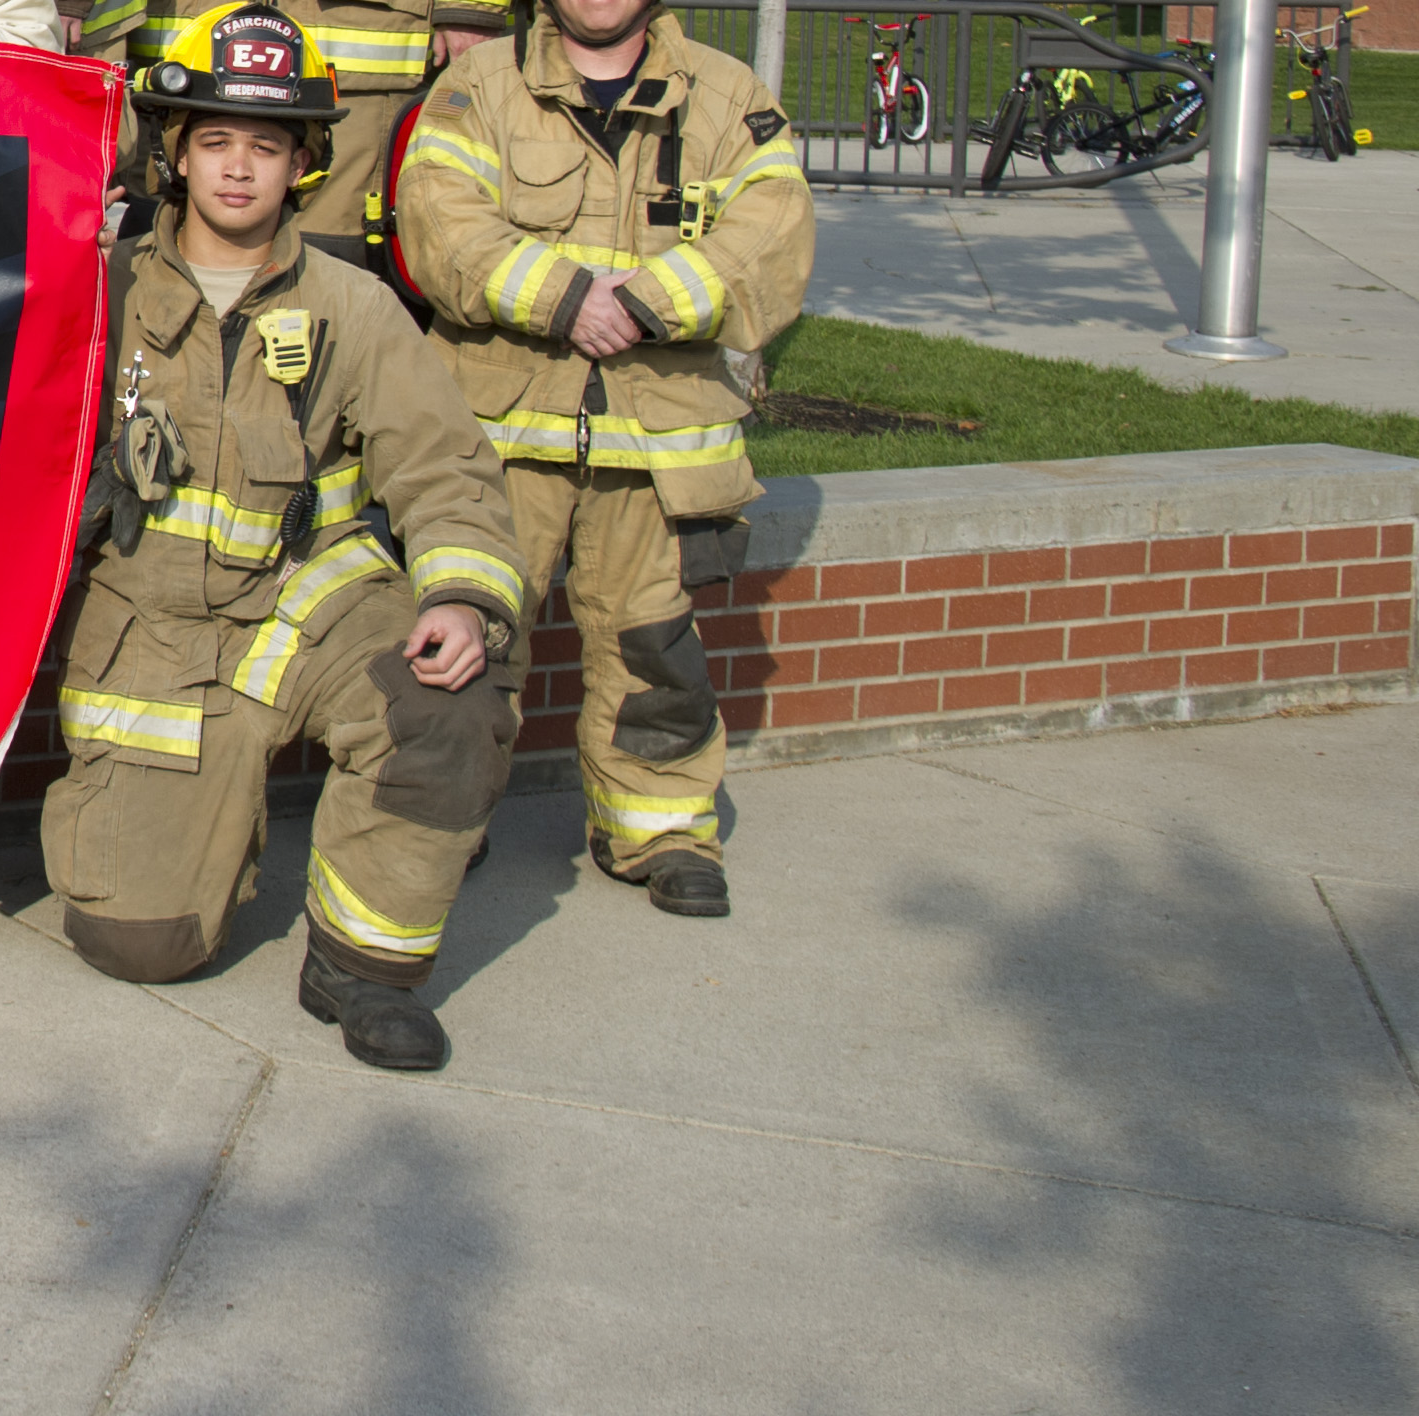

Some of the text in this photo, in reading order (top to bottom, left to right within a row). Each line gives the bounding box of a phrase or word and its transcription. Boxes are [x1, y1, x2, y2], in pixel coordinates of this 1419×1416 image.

[223, 18, 292, 36] FAIRCHILD
[233, 44, 284, 71] E-7
[225, 84, 287, 99] FIRE DEPARTMENT
